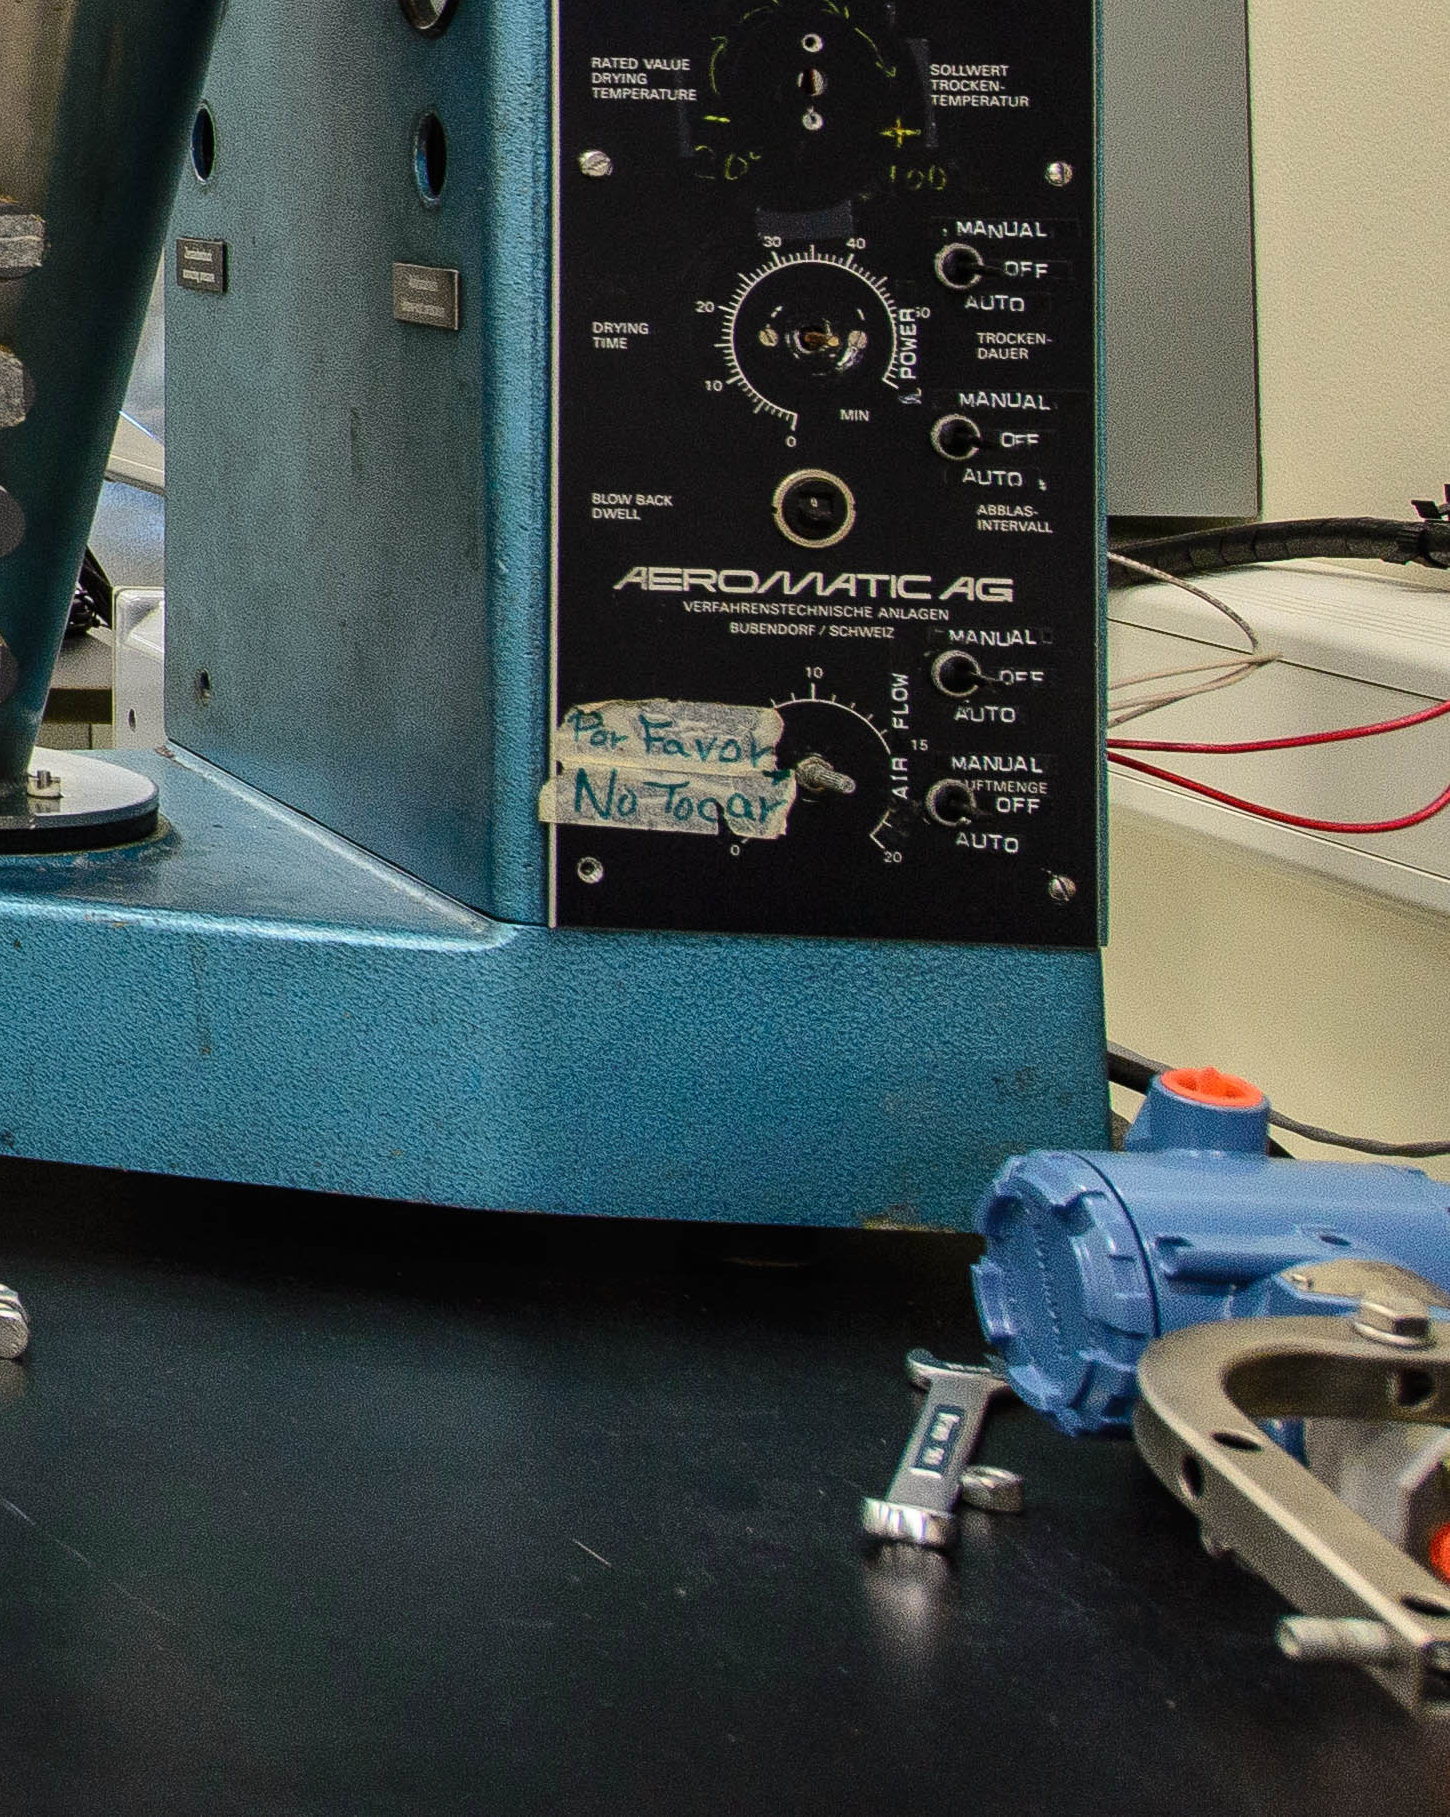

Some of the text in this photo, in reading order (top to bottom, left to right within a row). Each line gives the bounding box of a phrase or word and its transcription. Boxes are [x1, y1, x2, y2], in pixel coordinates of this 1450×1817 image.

[592, 58, 691, 72] RATED VALUE
[931, 64, 1009, 78] SOLLWERT
[592, 72, 648, 86] DRYING
[931, 79, 1006, 92] TROCKEN-
[592, 87, 698, 102] TEMPERATURE
[931, 94, 1030, 108] TEMPERATUR
[956, 221, 1048, 238] MANUAL
[763, 236, 782, 249] 30
[846, 236, 866, 250] 40
[1003, 261, 1048, 279] OFF
[695, 300, 715, 314] 20
[964, 295, 1025, 312] AUTO
[592, 321, 649, 335] DRYING
[592, 336, 628, 350] TIME
[898, 307, 919, 380] POWER
[977, 332, 1053, 346] TROCKEN-
[977, 346, 1029, 361] DAUER
[704, 379, 723, 393] 10
[958, 392, 1051, 411] MANUAL
[840, 409, 870, 422] MIN
[785, 436, 797, 448] 0
[1001, 432, 1040, 448] OFF
[962, 469, 1023, 487] AUTO
[592, 493, 673, 507] BLOW BACK
[592, 507, 641, 521] DWELL
[977, 504, 1039, 518] ABBLAS-
[977, 519, 1053, 534] INTERVALL
[612, 566, 1015, 602] AEROMATIC AG
[683, 601, 949, 621] VERFAHRENSTECHNISCHE ANLAGEN
[729, 622, 817, 637] BUBENDORF
[829, 625, 895, 640] SCHWEIZ
[948, 629, 1038, 647] MANUAL
[806, 666, 824, 679] 10
[999, 670, 1043, 684] OFF
[954, 706, 1016, 724] AUTO
[567, 710, 774, 769] Por Favor
[891, 673, 910, 800] AIR FLOW
[911, 739, 929, 751] 15
[951, 756, 1044, 774] MANUAL
[964, 779, 1049, 795] UFTMENGE
[574, 767, 787, 825] No Tocar
[996, 797, 1041, 814] OFF
[955, 831, 1019, 854] AUTO
[730, 845, 741, 857] 0
[883, 851, 903, 864] 20
